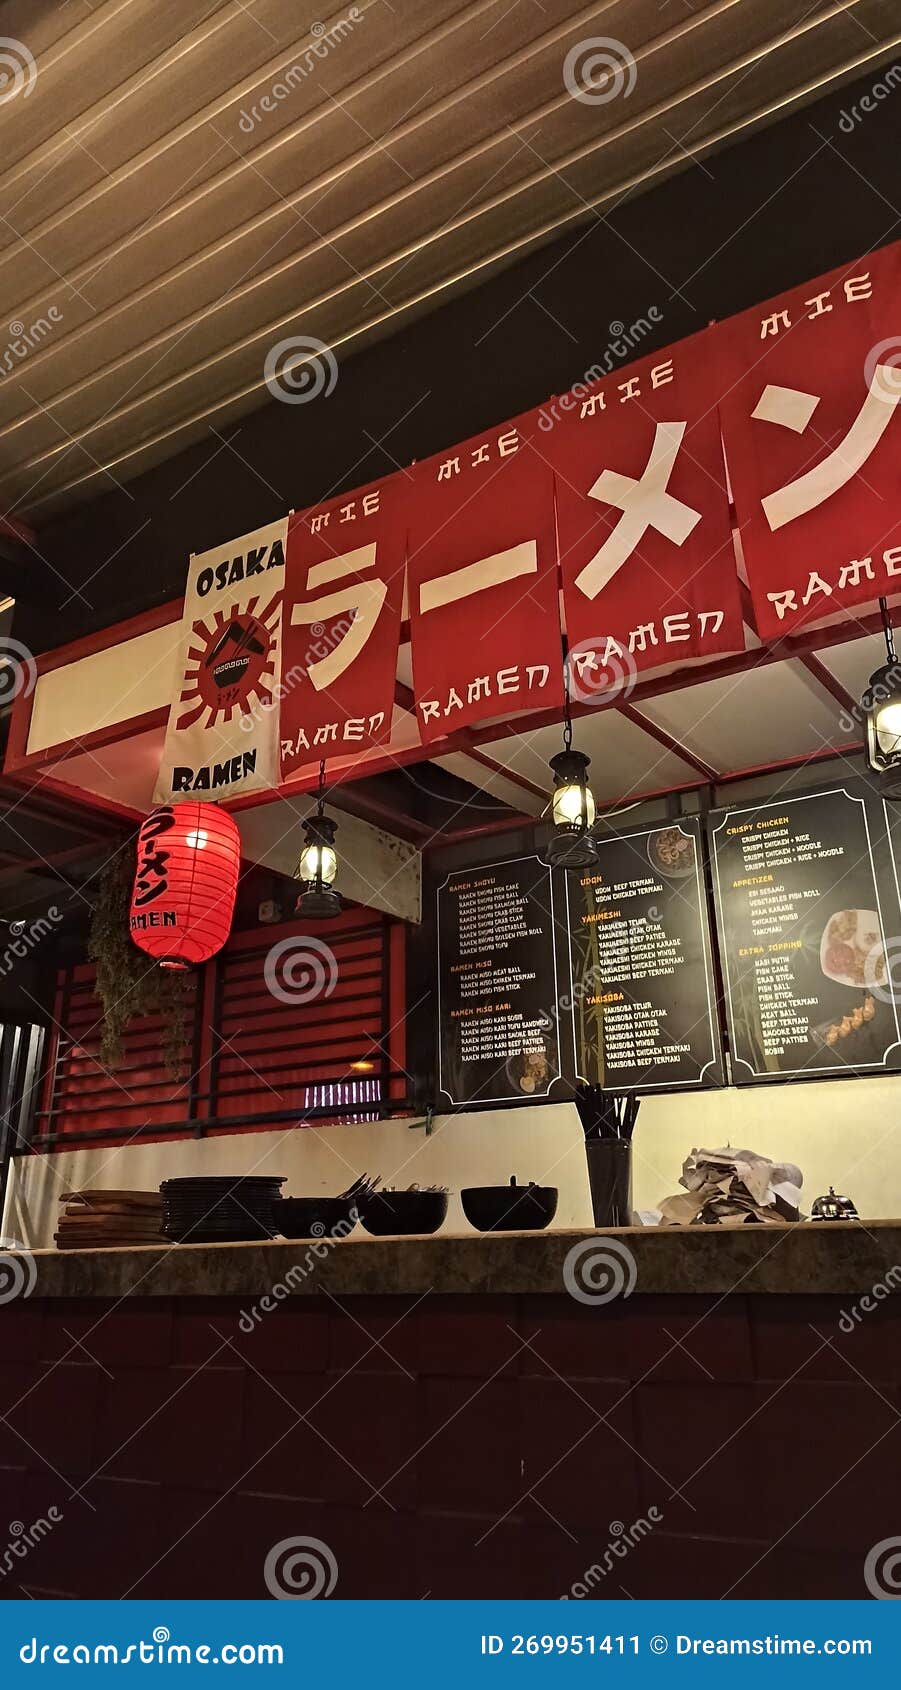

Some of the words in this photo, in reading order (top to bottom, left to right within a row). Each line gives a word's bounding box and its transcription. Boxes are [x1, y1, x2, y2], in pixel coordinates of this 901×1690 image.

[760, 272, 873, 339] MIE
[580, 359, 674, 419] MIE
[438, 429, 519, 482] MIE
[311, 490, 380, 535] MIE
[196, 540, 285, 597] OSAKA
[573, 611, 724, 676] RAMEN
[419, 664, 550, 725] RAMEN
[281, 712, 385, 761] RAMEN
[171, 748, 257, 791] RAMEN
[727, 824, 753, 835] CRISPY
[757, 817, 789, 829] CHICKEN
[742, 834, 762, 843] CRISPY
[764, 829, 788, 839] CHICKEN
[744, 852, 763, 862] CRISPY
[766, 847, 790, 858] CHICKEN
[797, 842, 821, 852] NOODLE
[745, 862, 765, 871] CRISPY
[767, 857, 792, 867] CHICKEN
[798, 853, 812, 862] RICE
[818, 848, 844, 858] NOODLE
[581, 876, 602, 885] UDON
[595, 886, 610, 894] UDON
[614, 883, 627, 891] BEEF
[629, 878, 654, 888] TERIYAKI
[733, 875, 773, 887] APPETIZER
[449, 883, 470, 892] RAMEN
[596, 894, 611, 902] UDON
[613, 890, 636, 900] CHICKEN
[638, 885, 662, 895] TERIYAKI
[804, 889, 820, 898] ROLL
[459, 892, 476, 900] RAMEN
[582, 911, 621, 922] YAKIMESHI
[752, 916, 777, 926] CHICKEN
[646, 924, 661, 932] OTAK
[460, 939, 477, 947] RAMEN
[529, 928, 543, 936] ROLL
[739, 946, 763, 956] EXTRA
[769, 941, 802, 952] TOPPING
[631, 952, 656, 961] CHICKEN
[658, 949, 676, 957] WINGS
[451, 963, 472, 972] RAMEN
[476, 960, 492, 968] MISO
[632, 961, 656, 970] CHICKEN
[658, 958, 684, 966] TERIYAKI
[756, 967, 769, 975] FISH
[772, 965, 788, 973] CAKE
[601, 973, 631, 983] YAKIMESHI
[632, 971, 646, 979] BEEF
[648, 967, 674, 977] TERIYAKI
[757, 976, 774, 984] CRAB
[776, 974, 794, 982] STICK
[774, 983, 790, 991] BALL
[586, 993, 624, 1004] YAKISOBA
[775, 992, 793, 1000] STICK
[451, 1008, 473, 1016] RAMEN
[496, 1003, 511, 1011] KARI
[604, 1005, 632, 1014] YAKISOBA
[760, 1001, 786, 1010] CHICKEN
[789, 998, 818, 1007] TERIYAKI
[604, 1014, 632, 1023] YAKISOBA
[651, 1009, 667, 1017] OTAK
[761, 1011, 777, 1019] MEAT
[780, 1009, 796, 1017] BALL
[605, 1023, 633, 1032] YAKISOBA
[761, 1020, 777, 1028] BEEF
[780, 1017, 808, 1026] TERIYAKI
[461, 1028, 479, 1036] RAMEN
[793, 1026, 808, 1034] BEEF
[605, 1032, 633, 1041] YAKISOBA
[606, 1041, 634, 1050] YAKISOBA
[636, 1039, 654, 1047] WINGS
[606, 1051, 635, 1059] YAKISOBA
[636, 1048, 662, 1056] CHICKEN
[663, 1044, 690, 1053] TERIYAKI
[607, 1060, 636, 1068] YAKISOBA
[638, 1058, 652, 1066] BEEF
[653, 1056, 680, 1064] TERIYAKI
